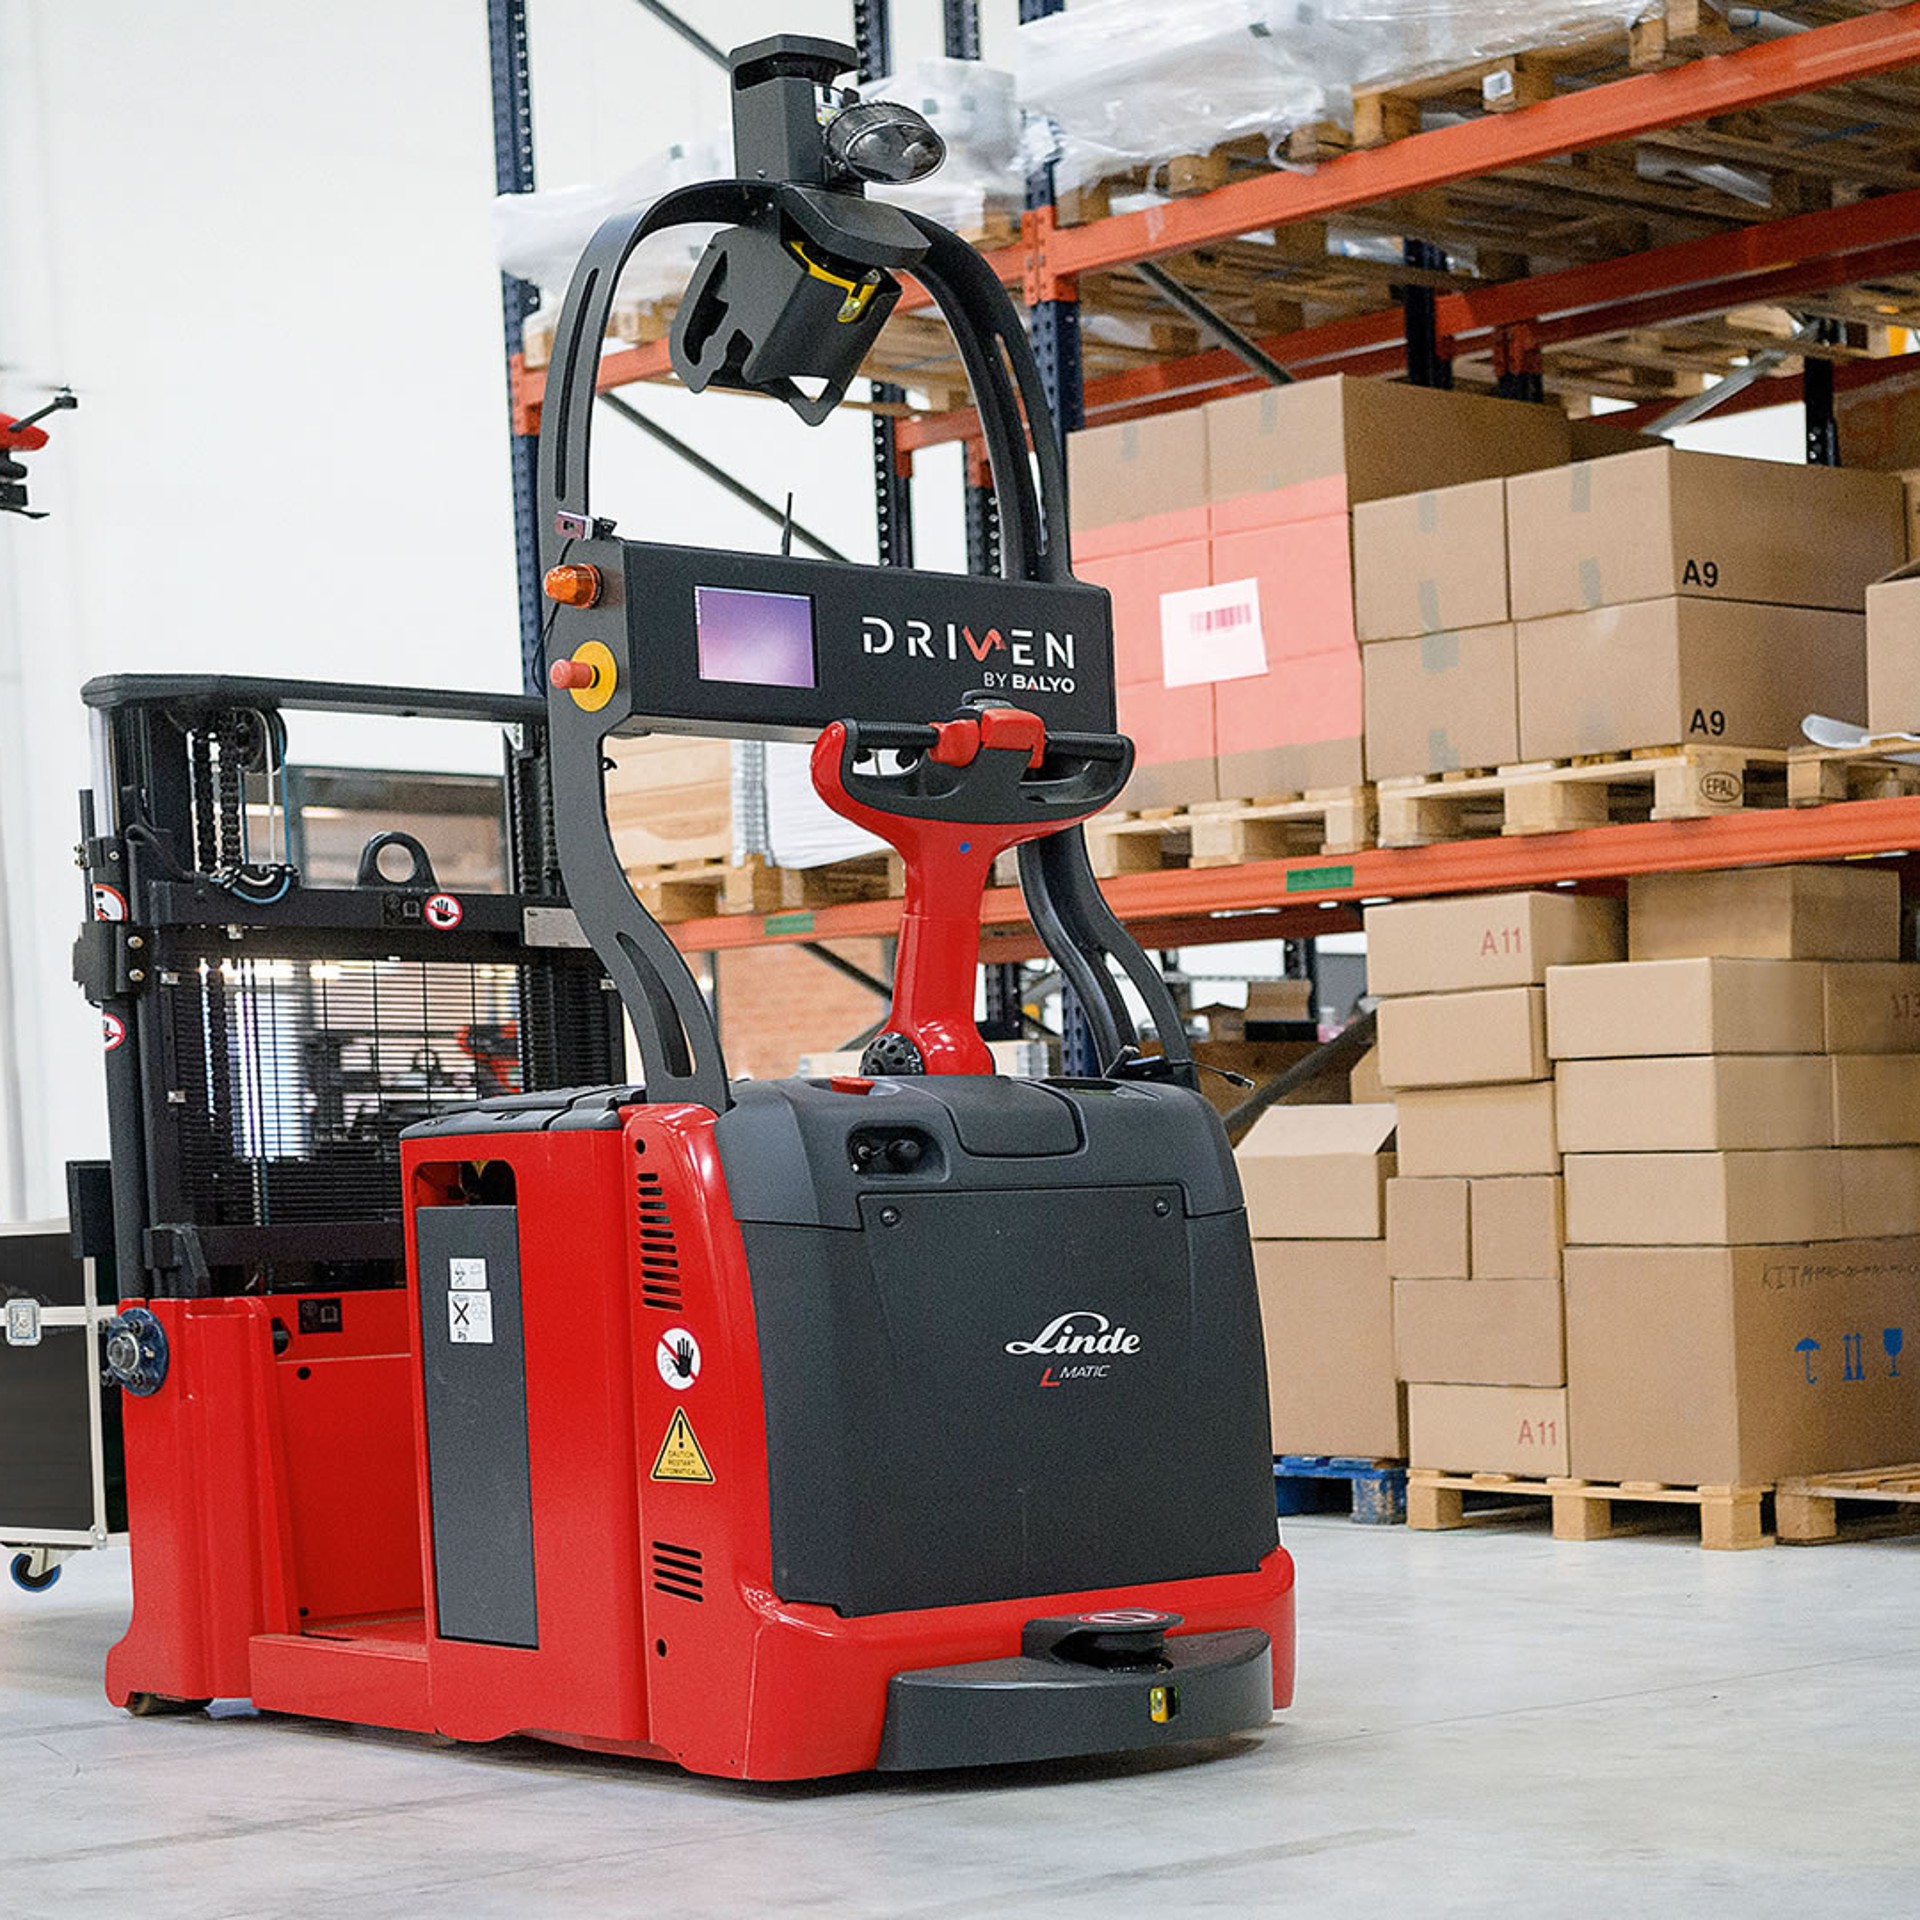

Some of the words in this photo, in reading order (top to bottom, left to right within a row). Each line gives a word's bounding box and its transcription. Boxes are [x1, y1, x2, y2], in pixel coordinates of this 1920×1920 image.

[1682, 559, 1718, 588] A9
[862, 616, 1075, 669] DRIVEN
[983, 671, 1007, 688] BY
[1012, 674, 1076, 694] BALYO
[1689, 708, 1725, 736] A9
[1481, 926, 1522, 957] A11
[1005, 1311, 1141, 1354] Linde
[1059, 1364, 1111, 1379] MATIC
[1518, 1419, 1556, 1446] A11
